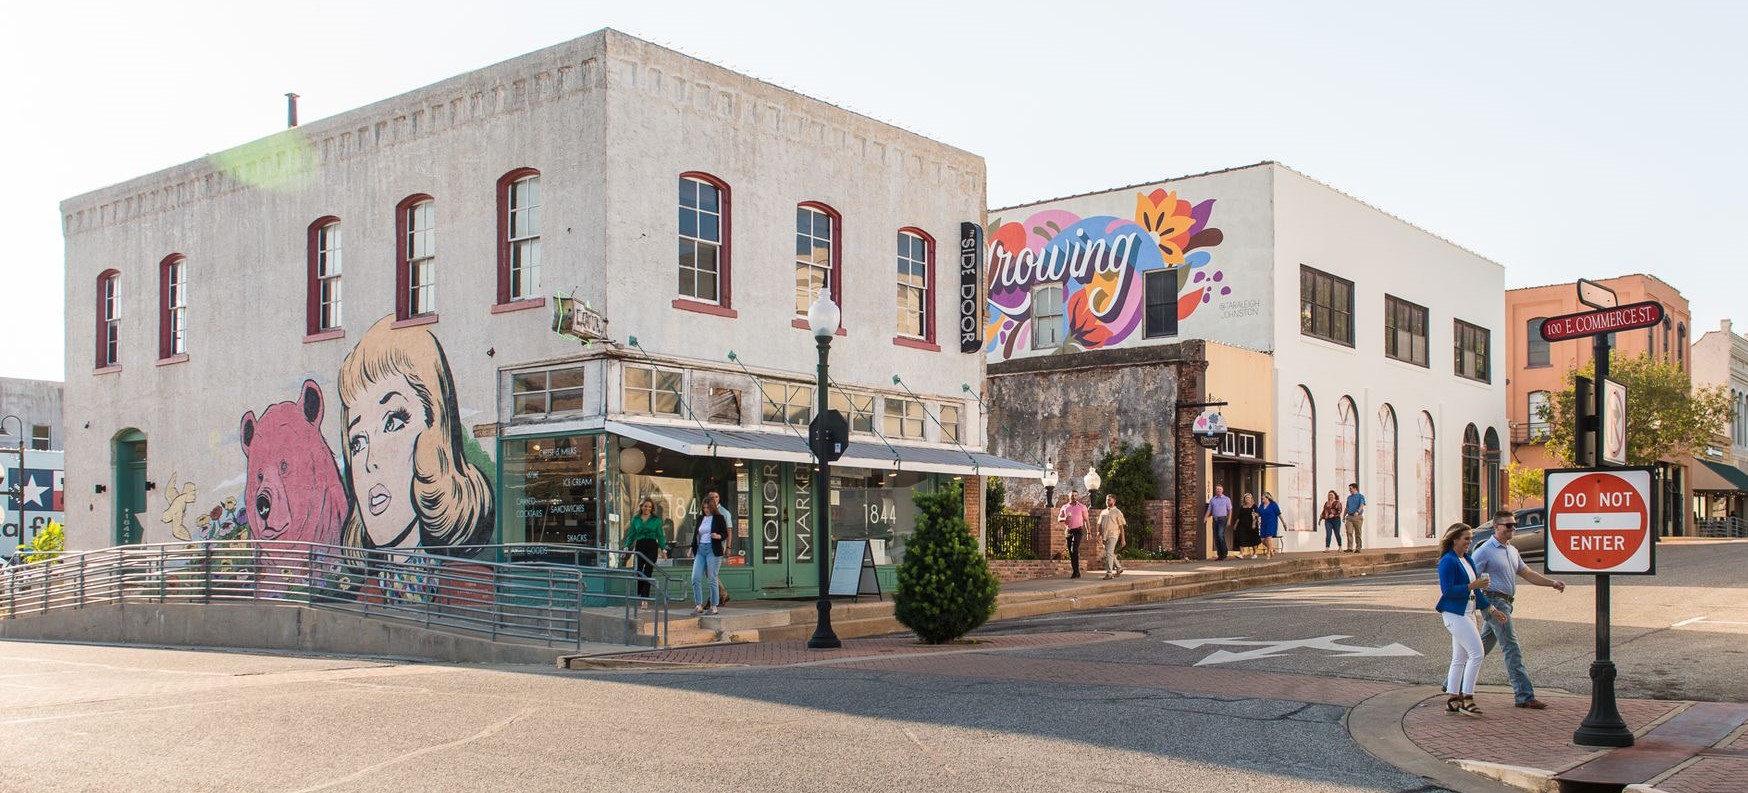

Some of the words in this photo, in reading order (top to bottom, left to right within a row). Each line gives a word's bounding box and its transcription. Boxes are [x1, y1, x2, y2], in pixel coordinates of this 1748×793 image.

[961, 238, 976, 275] SIDE
[961, 283, 976, 344] DOOR
[1547, 323, 1561, 335] 100
[1566, 319, 1575, 334] E.
[1576, 308, 1637, 332] COMMERCE
[1639, 306, 1655, 322] ST.
[572, 478, 592, 486] CREAM
[551, 505, 585, 514] SANDWICHES
[666, 495, 703, 520] 184
[763, 464, 779, 560] LIQUOR
[794, 463, 811, 560] MARKET
[1564, 493, 1587, 508] DO
[1599, 492, 1633, 507] NOT
[863, 504, 897, 525] 1844
[1570, 536, 1625, 551] ENTER
